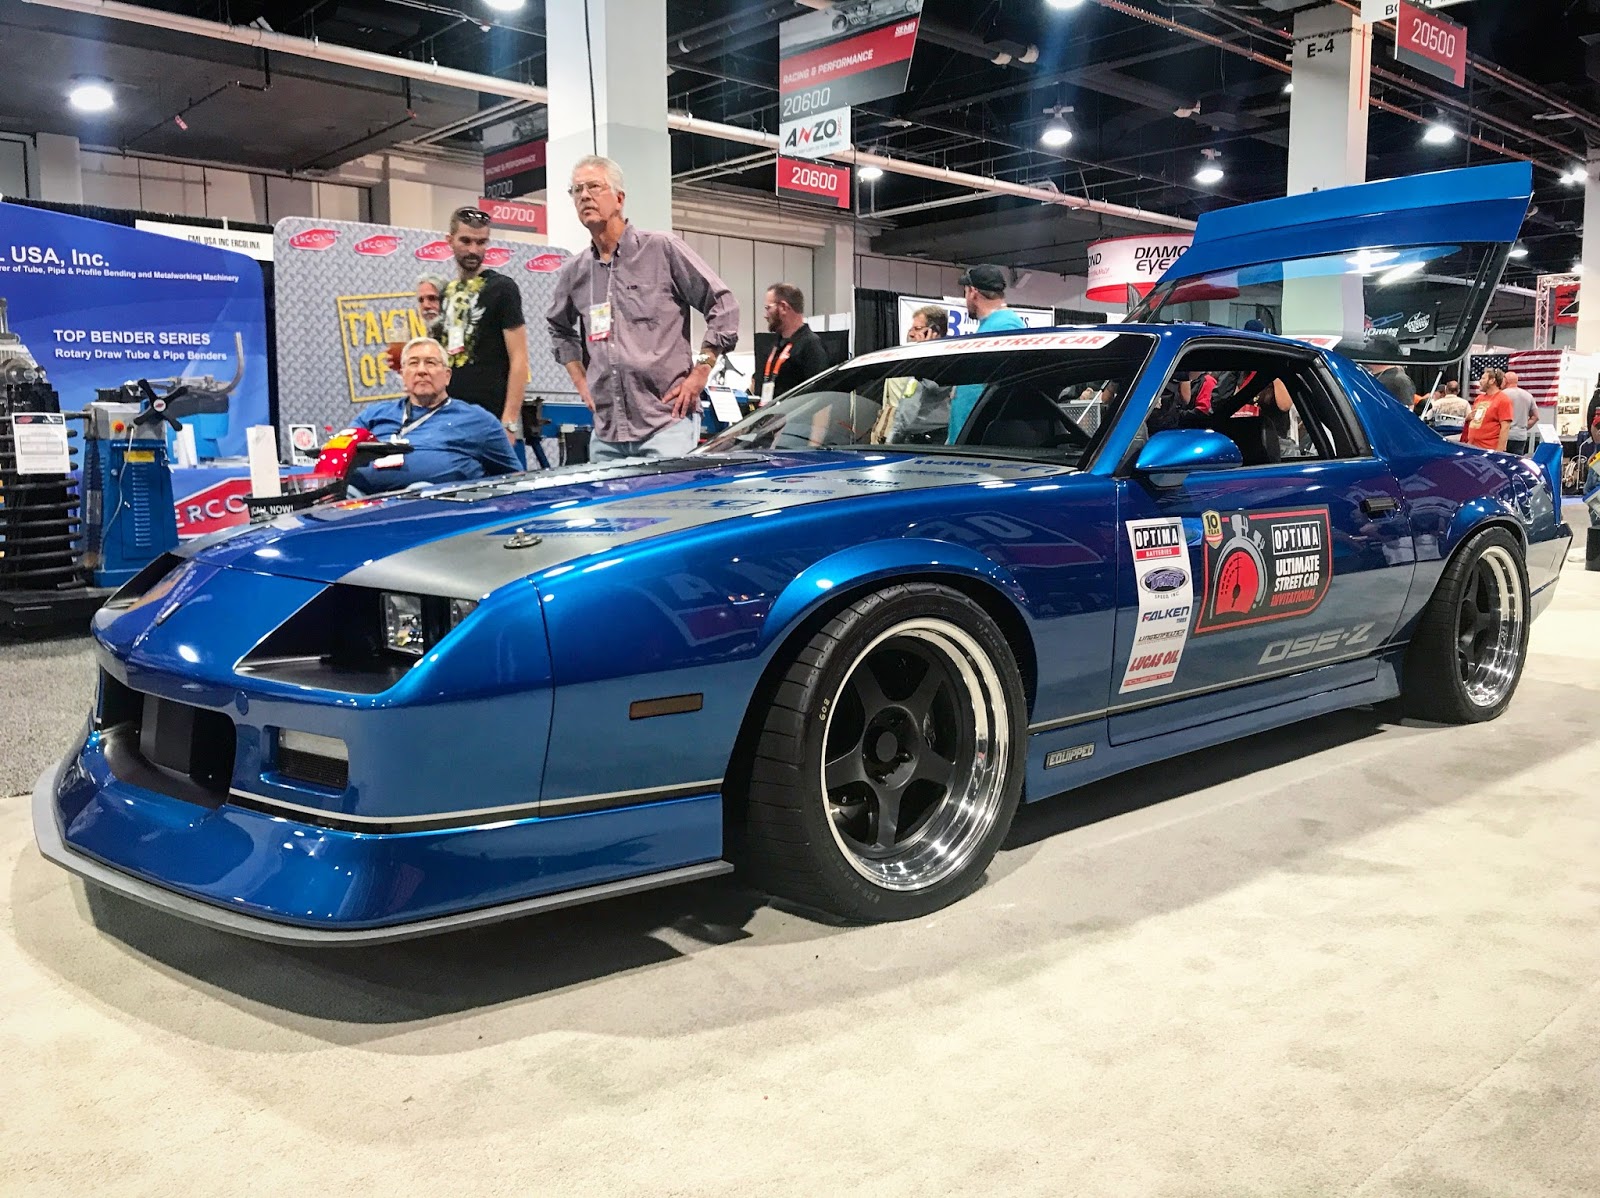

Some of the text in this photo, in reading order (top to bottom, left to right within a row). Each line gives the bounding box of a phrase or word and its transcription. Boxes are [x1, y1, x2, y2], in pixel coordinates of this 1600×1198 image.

[1411, 18, 1455, 58] 20500
[1306, 38, 1335, 58] E-4
[783, 69, 810, 84] RACING
[818, 49, 874, 74] PERFORMANCE
[783, 87, 831, 117] 20600
[785, 119, 837, 147] ANZO
[791, 166, 838, 191] 20600
[493, 205, 535, 222] 20700
[204, 237, 216, 246] USA
[218, 238, 229, 247] INC
[10, 245, 110, 267] USA, Inc.
[23, 265, 46, 274] Tube,
[47, 267, 65, 276] Pipe
[68, 267, 74, 275] &
[76, 268, 102, 276] Profile
[104, 269, 136, 279] Bending
[138, 270, 152, 278] and
[154, 271, 202, 281] Metalworking
[203, 273, 239, 283] Machinery
[53, 329, 211, 345] TOP BENDER SERIES
[988, 336, 1057, 347] STREET
[1059, 335, 1105, 345] CAR
[55, 348, 227, 361] Rotary Draw Tube & Pipe Benders
[914, 459, 991, 468] Holley
[269, 504, 294, 514] NOW!
[1205, 514, 1218, 529] 10
[1135, 528, 1178, 547] OPTIMA
[1274, 526, 1319, 550] OPTIMA
[1145, 549, 1172, 557] BATTERIES
[1275, 554, 1320, 576] ULTIMATE
[1274, 572, 1319, 592] STREET CAR
[1270, 588, 1316, 607] INVITATIONAL
[1142, 606, 1190, 622] FALKEN
[1129, 650, 1179, 672] LUCAS OIL
[1048, 744, 1095, 766] EQUIPPED
